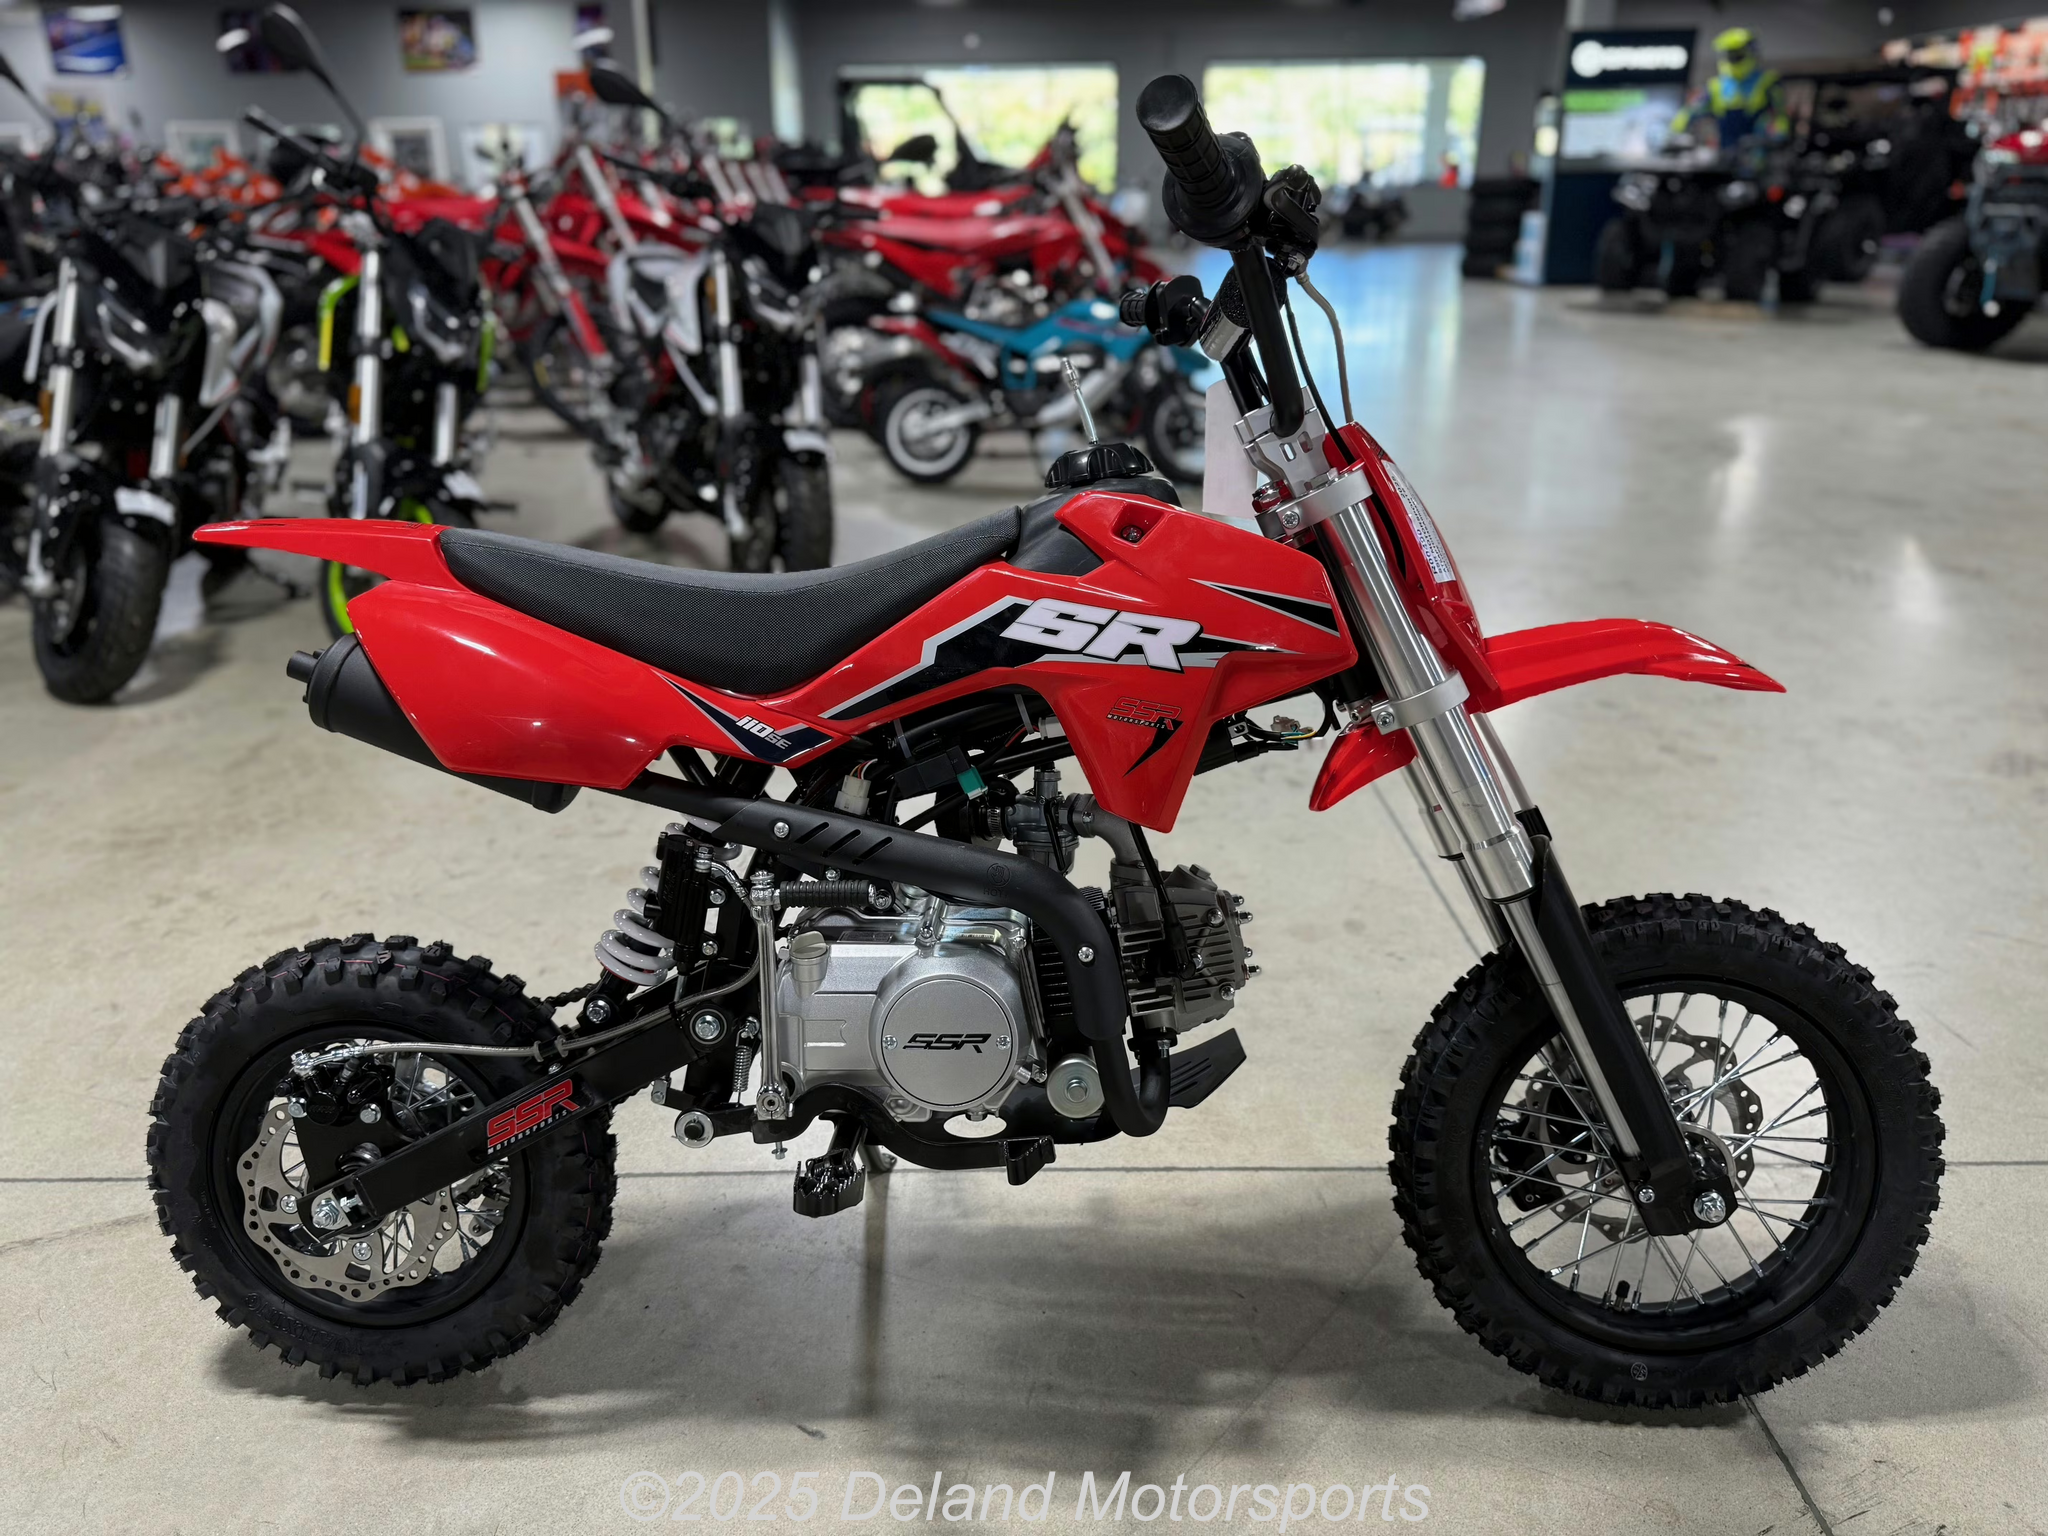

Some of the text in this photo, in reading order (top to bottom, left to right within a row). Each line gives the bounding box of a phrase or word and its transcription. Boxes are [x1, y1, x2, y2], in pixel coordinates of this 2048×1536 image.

[1107, 714, 1166, 729] MOTORSPORTS
[1109, 697, 1182, 731] SSR
[902, 1033, 992, 1053] SSR
[487, 1079, 580, 1148] SSR
[487, 1109, 567, 1155] MOTORSPORTS
